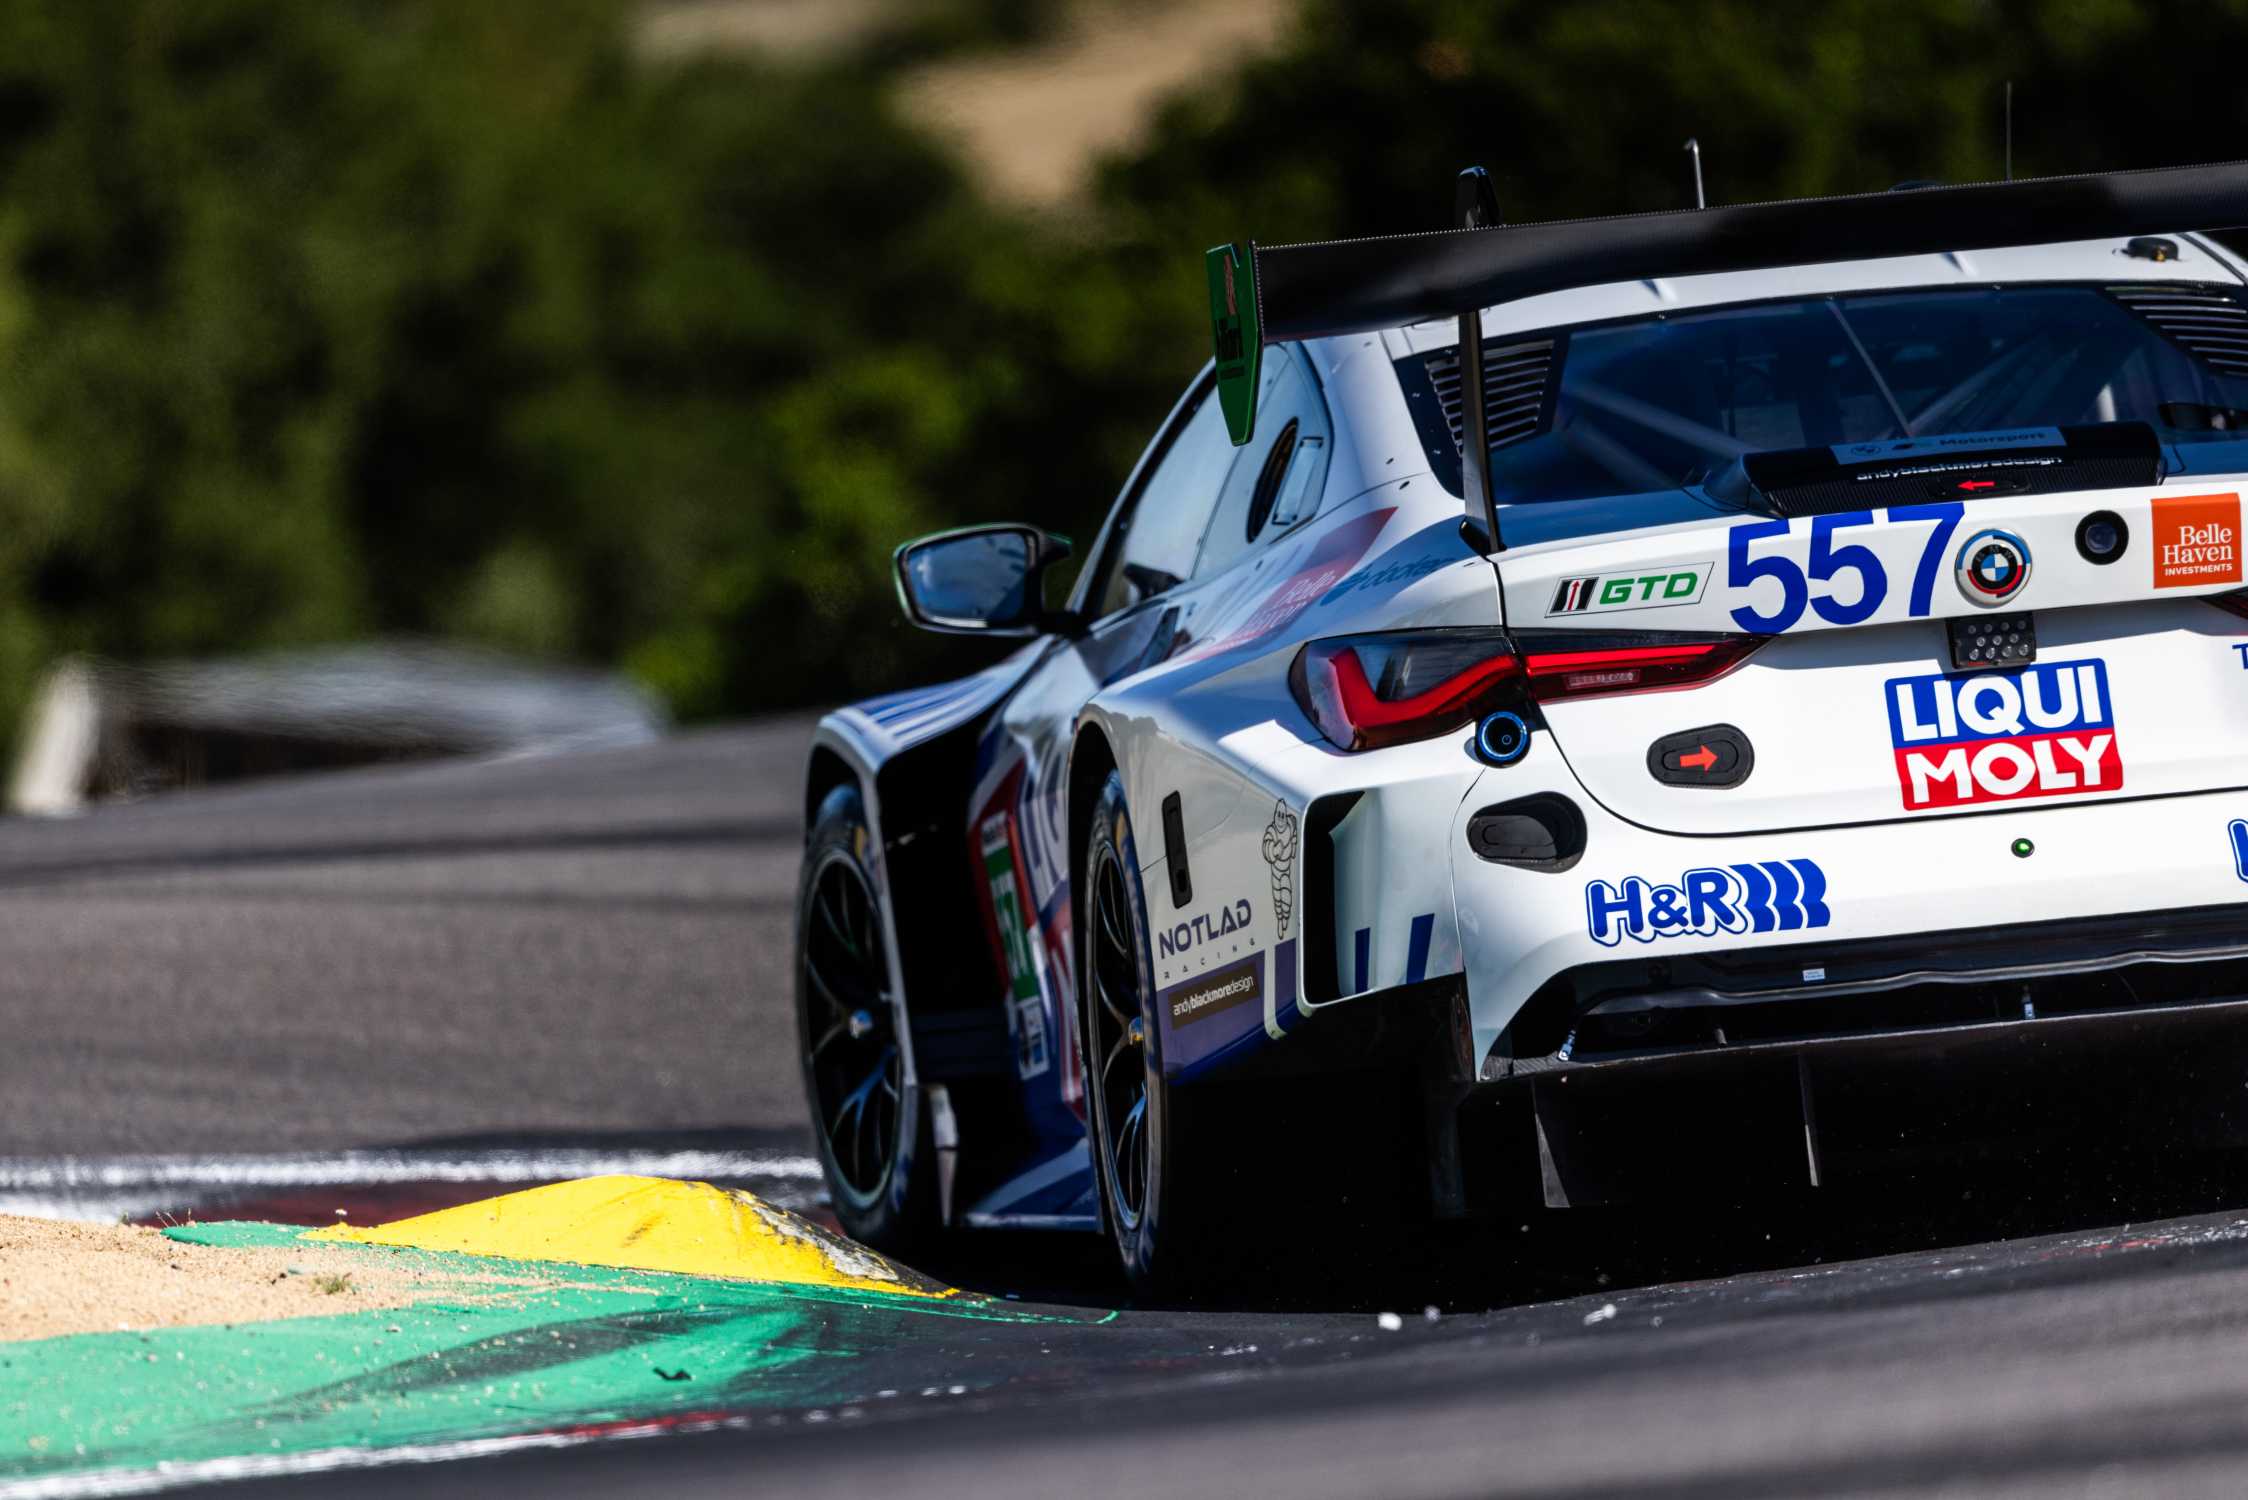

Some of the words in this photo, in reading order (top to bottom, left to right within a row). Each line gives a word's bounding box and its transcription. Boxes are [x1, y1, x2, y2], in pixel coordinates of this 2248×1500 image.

[2161, 543, 2233, 566] Haven
[2178, 523, 2233, 547] Belle
[1599, 571, 1699, 605] GTD
[1728, 502, 1966, 636] 557
[2164, 562, 2233, 577] INVESTMENTS
[1895, 664, 2103, 742] LIQUI
[1905, 733, 2113, 804] MOLY
[1586, 867, 1748, 946] H&R
[1158, 898, 1252, 960] NOTLAD
[1163, 937, 1256, 980] RACING
[1172, 974, 1255, 1017] andyblackmoredesign
